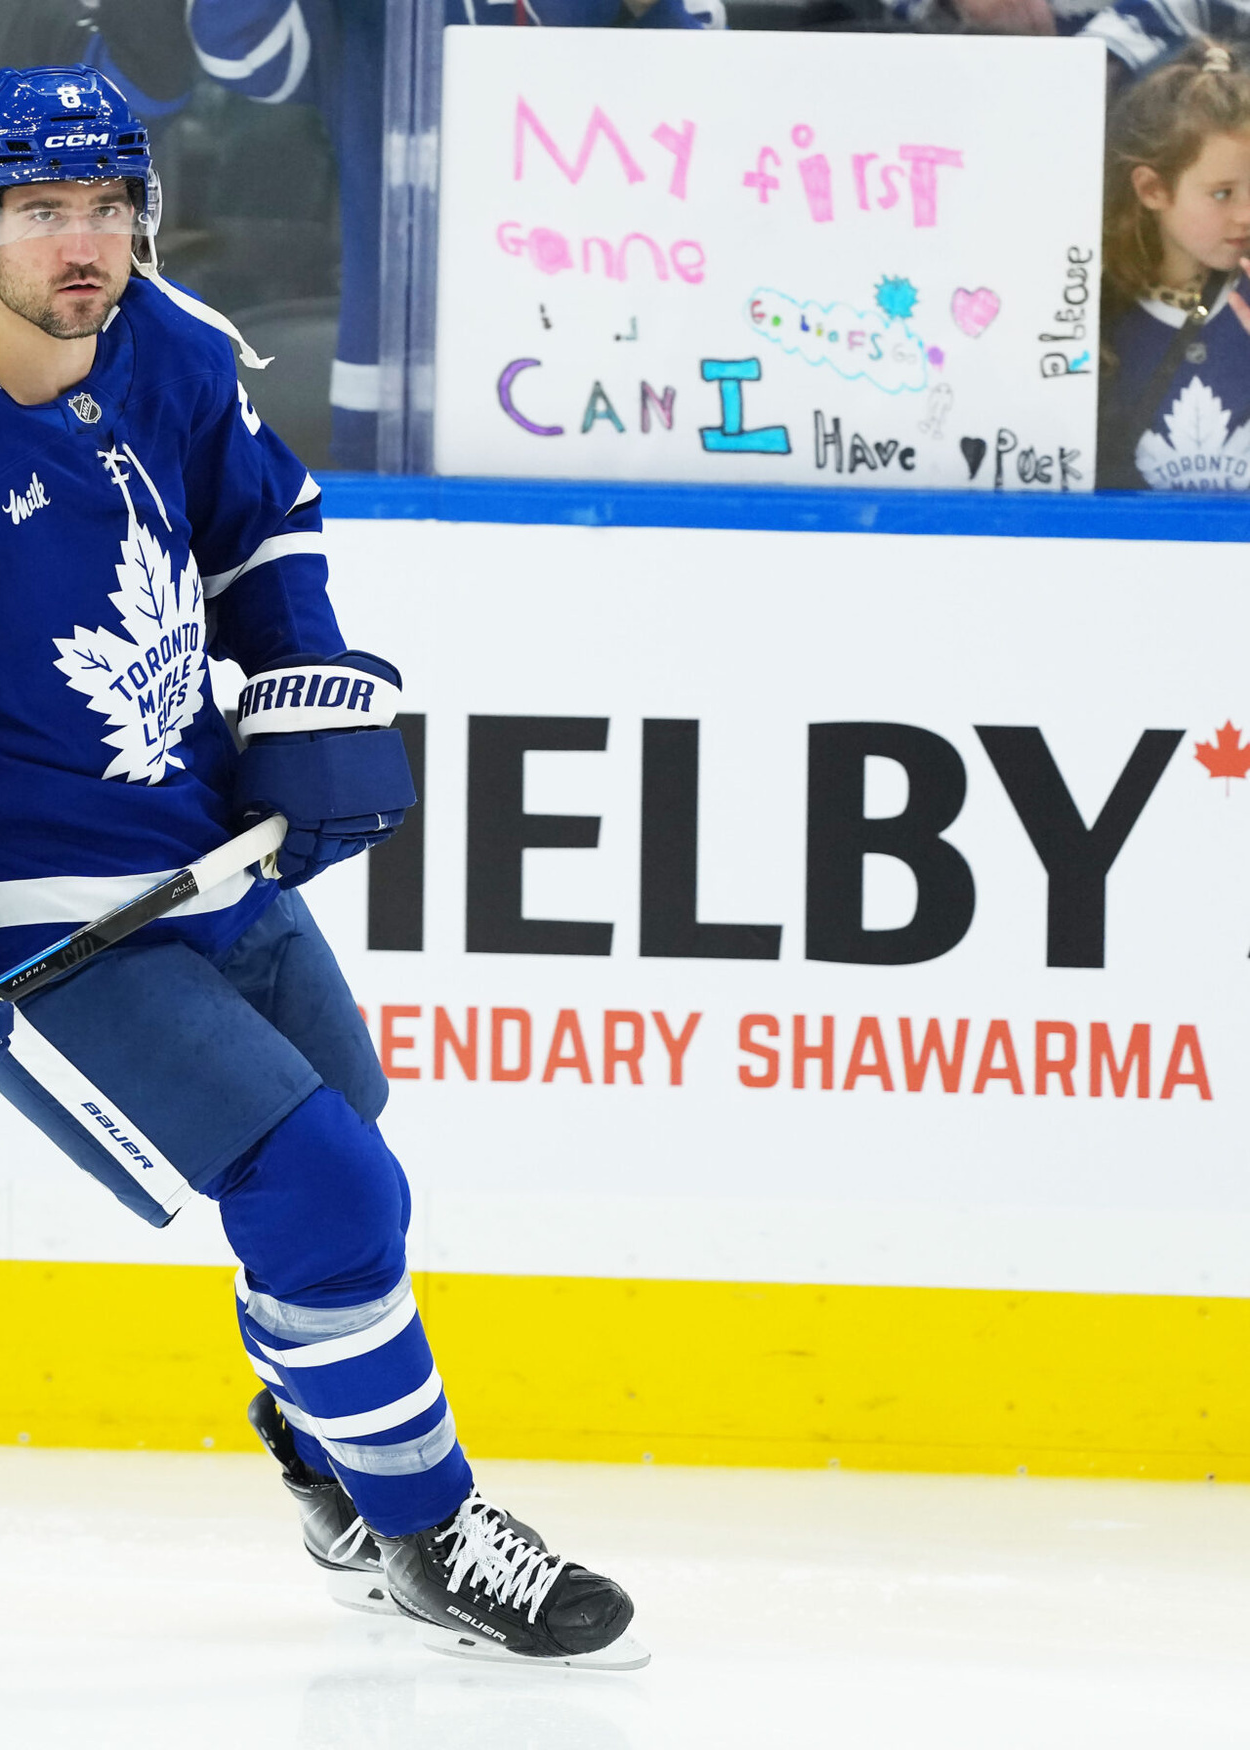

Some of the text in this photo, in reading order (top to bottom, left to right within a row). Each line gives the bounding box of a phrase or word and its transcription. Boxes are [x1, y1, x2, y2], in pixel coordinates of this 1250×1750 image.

[56, 84, 82, 109] 8
[44, 132, 110, 149] CCM
[512, 93, 696, 201] My
[698, 356, 793, 455] I
[1, 471, 51, 525] Milk
[1154, 453, 1248, 482] TORONTO
[108, 622, 199, 702] TORONTO
[137, 654, 192, 719] MAPLE
[143, 682, 188, 747] LEAFS
[237, 674, 376, 724] ARRIOR
[366, 711, 1188, 970] ELBY
[11, 962, 47, 987] ALPHA
[378, 1003, 1214, 1102] ENDARY SHAWARMA
[80, 1101, 154, 1170] BAUER
[445, 1605, 507, 1642] BAUER
